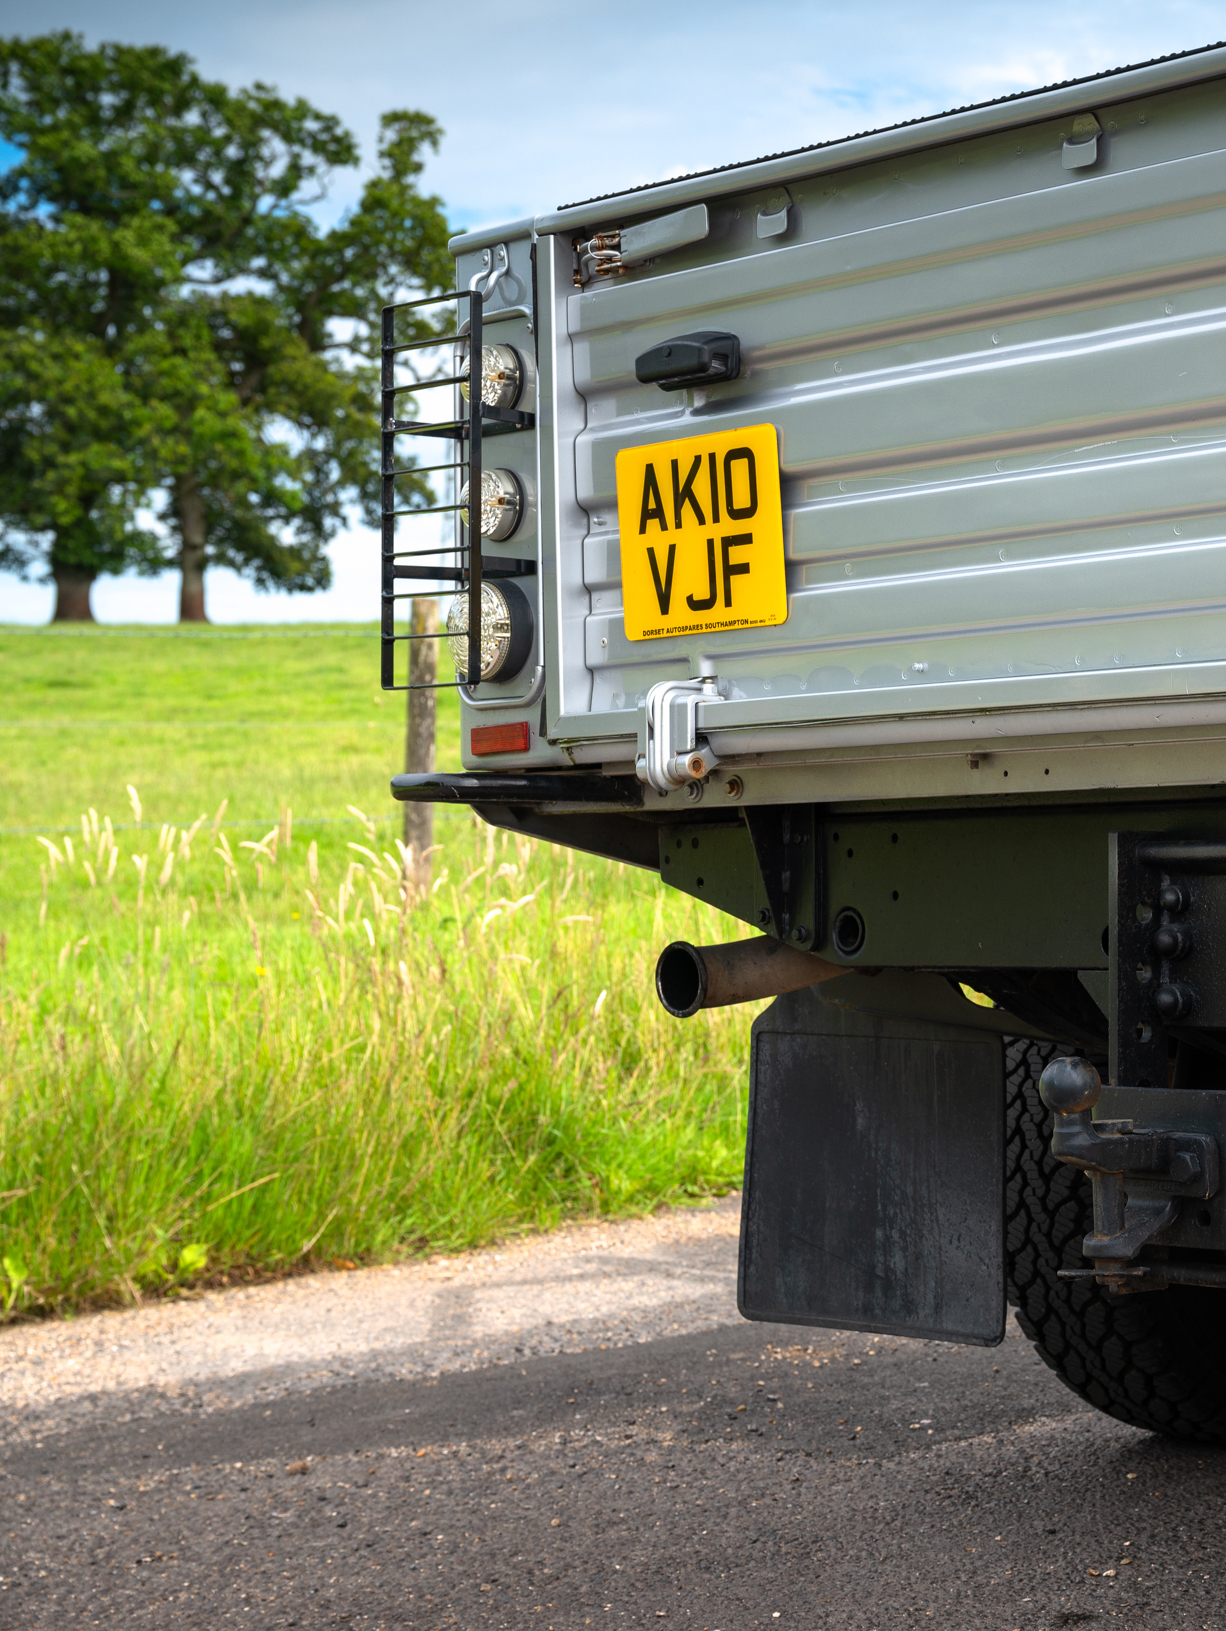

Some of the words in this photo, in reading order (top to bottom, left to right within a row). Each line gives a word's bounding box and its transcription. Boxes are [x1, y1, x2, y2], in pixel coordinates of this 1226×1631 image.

[638, 446, 759, 535] AK10
[646, 532, 754, 616] VJF
[642, 628, 665, 637] DORSET
[665, 623, 704, 634] AUTOSPARES
[704, 618, 749, 630] SOUTHAMPTON
